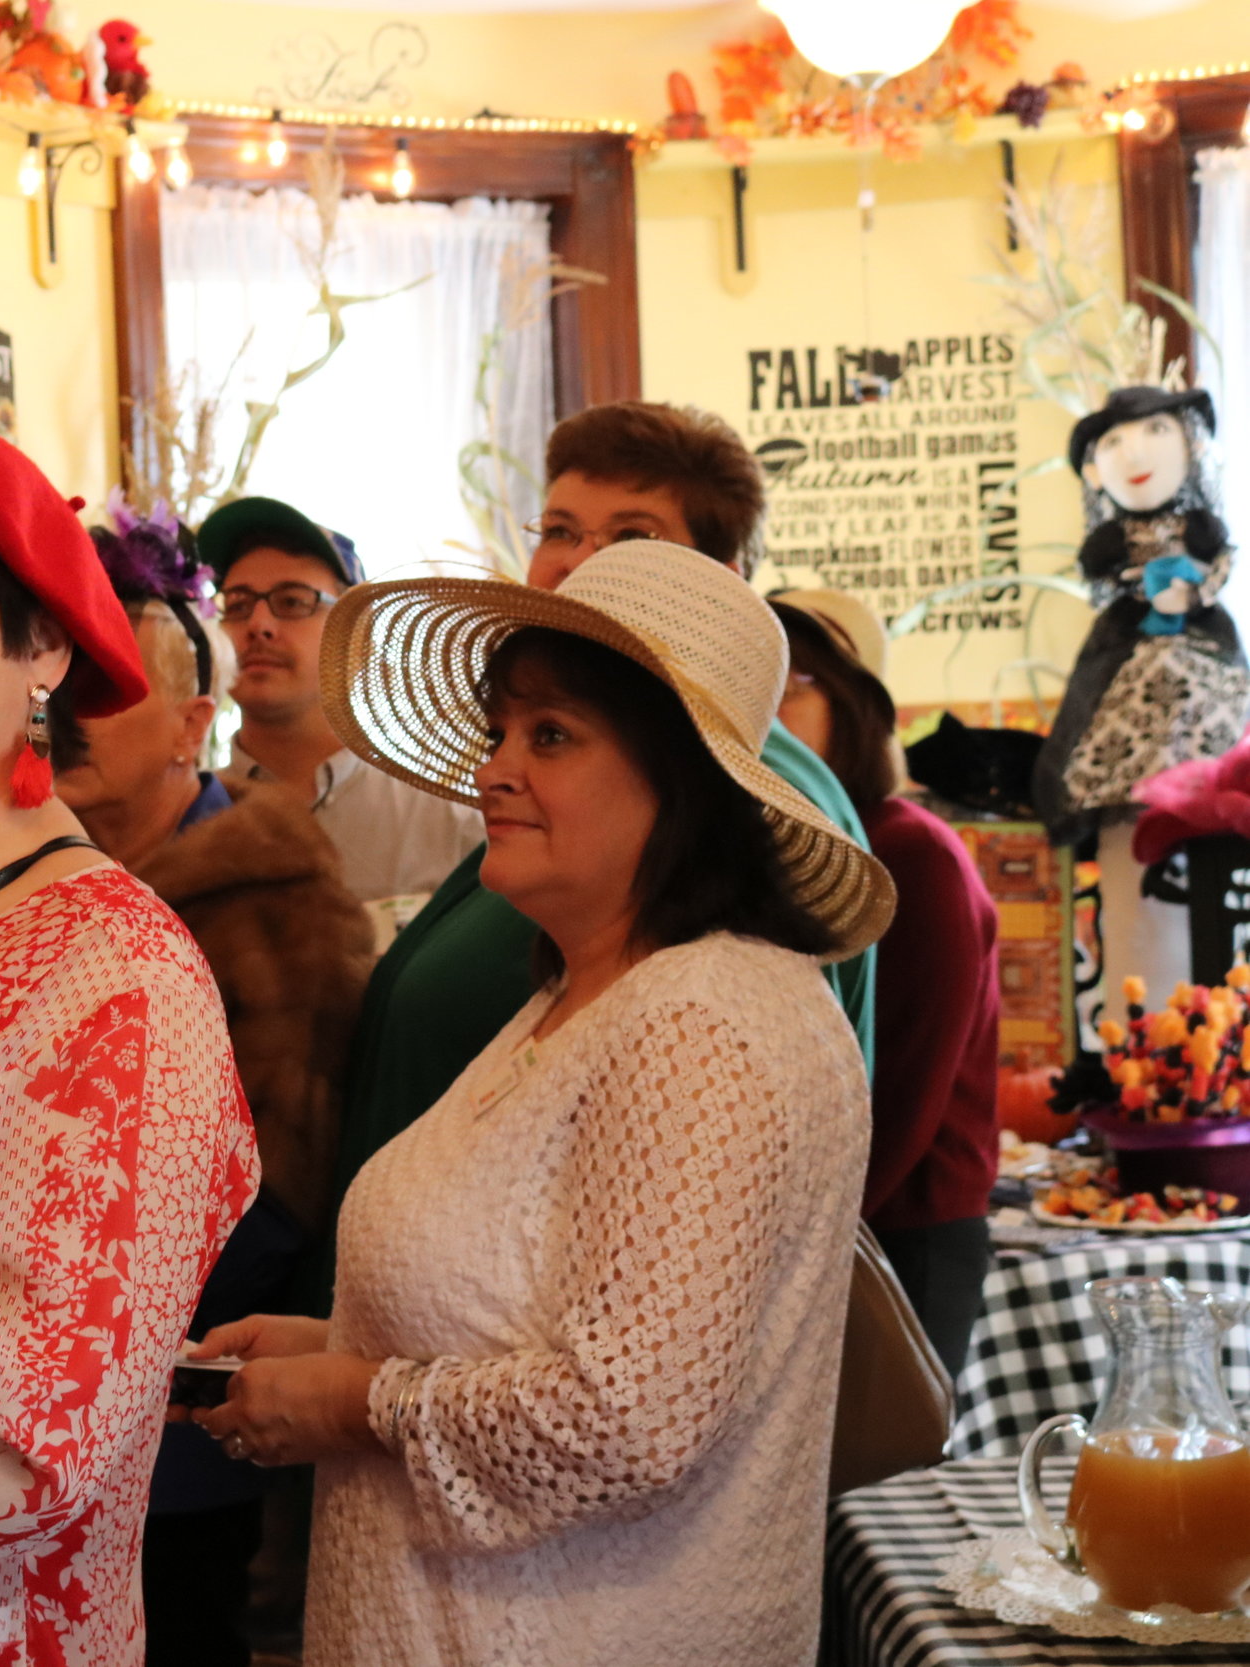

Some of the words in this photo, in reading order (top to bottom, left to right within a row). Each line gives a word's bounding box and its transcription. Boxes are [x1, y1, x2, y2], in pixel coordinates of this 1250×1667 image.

[906, 333, 1015, 368] APPLES
[748, 345, 864, 412] FALL
[887, 370, 1014, 405] ARVEST
[748, 412, 850, 437] LEAVES
[857, 410, 901, 431] ALL
[910, 403, 1017, 427] AROUND
[813, 434, 916, 462] football
[927, 431, 1017, 460] games
[768, 456, 924, 490] Autumn
[769, 519, 837, 539] VERY
[848, 515, 910, 536] LEAF
[956, 512, 970, 530] A
[820, 567, 907, 590] SCHOOL
[917, 563, 974, 587] DAYS
